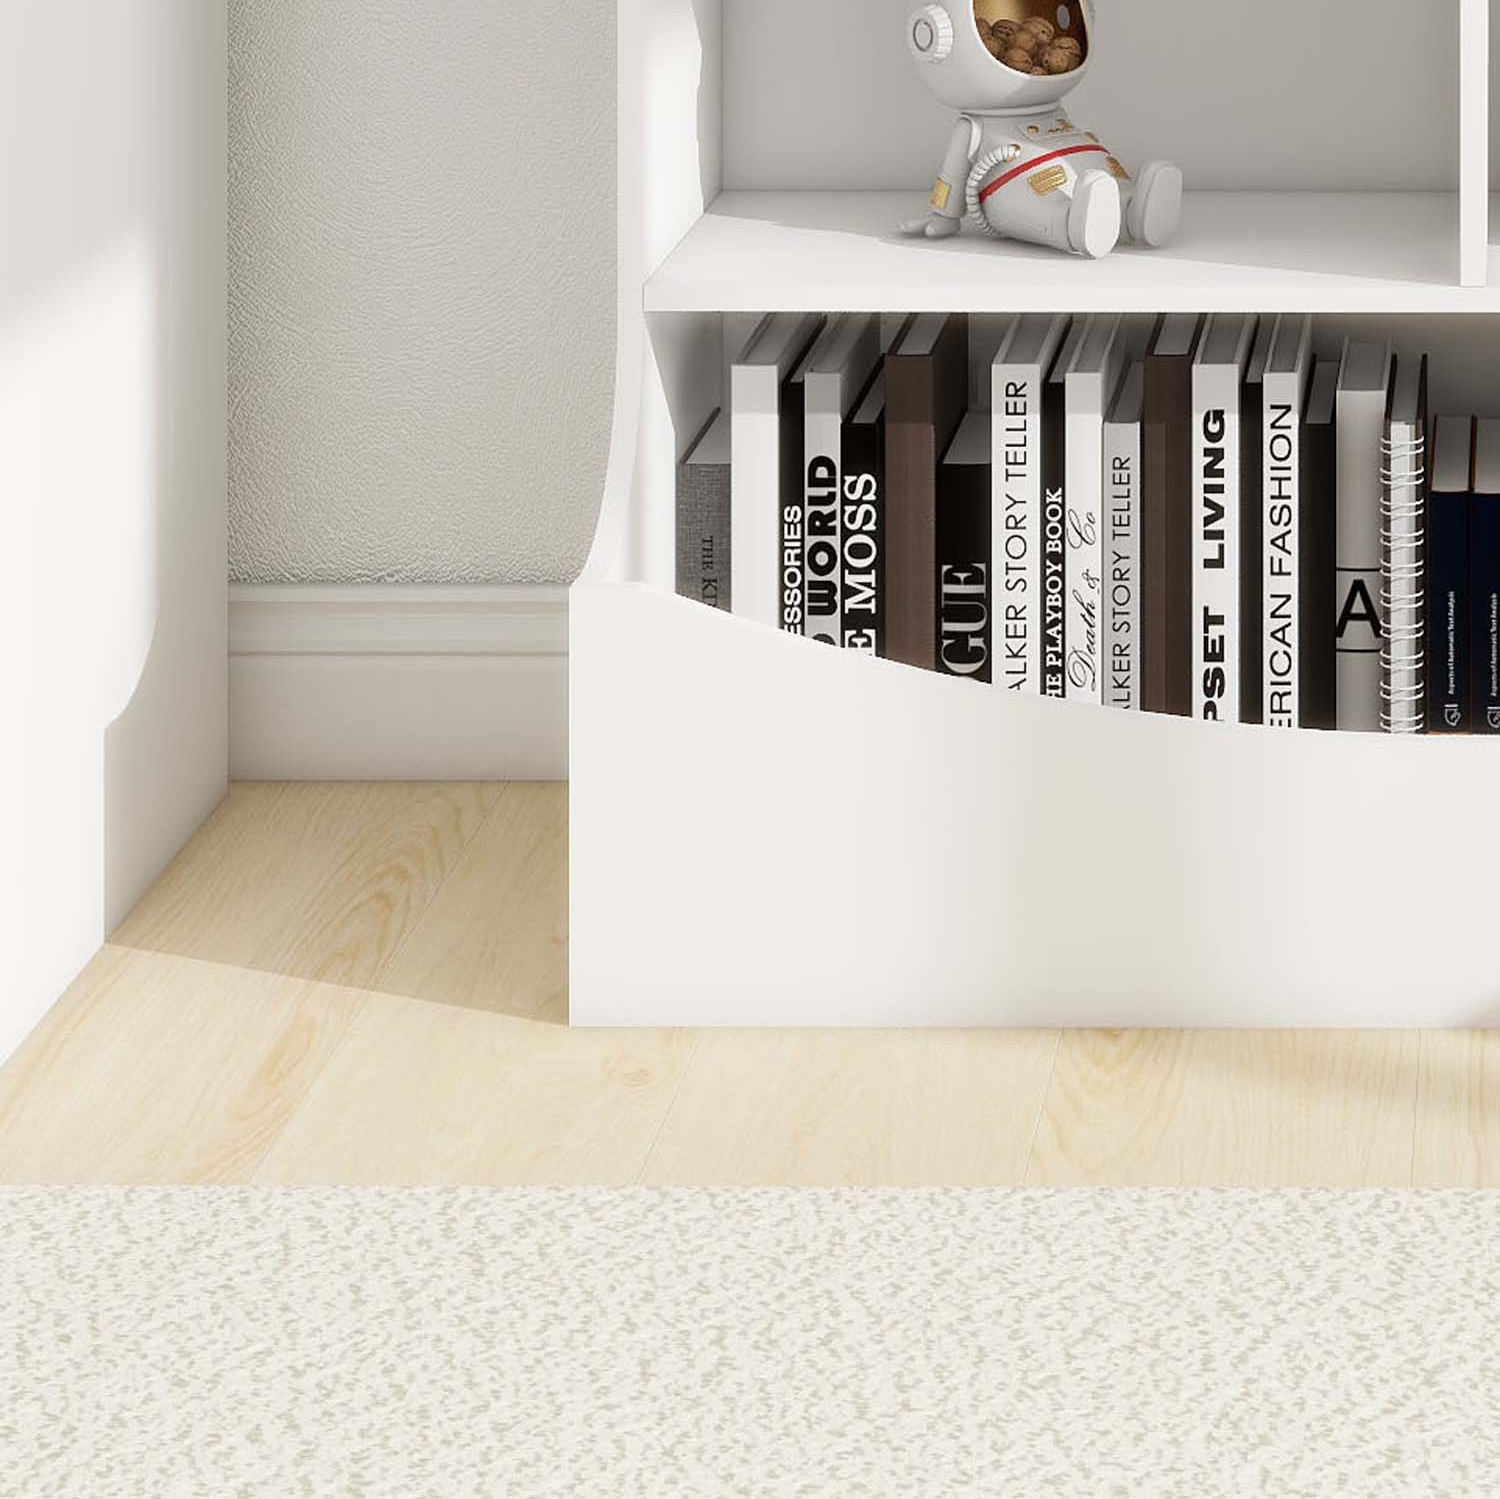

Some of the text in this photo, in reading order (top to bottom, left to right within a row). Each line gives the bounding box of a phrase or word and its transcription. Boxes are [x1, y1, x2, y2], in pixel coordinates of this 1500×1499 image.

[1005, 382, 1027, 482] TELLER
[807, 454, 838, 616] WORLD
[843, 473, 877, 614] MOSS
[1005, 493, 1027, 593] STORY
[1045, 487, 1063, 554] BOOK
[1112, 456, 1131, 541] TELLER
[1269, 404, 1292, 576] FASHION
[702, 535, 714, 571] THE
[783, 505, 802, 635] ESSORIES
[1065, 509, 1100, 691] Death & Co
[1112, 550, 1131, 633] STORY
[1203, 409, 1225, 721] PSET LIVING
[940, 562, 988, 674] GUE
[1045, 559, 1063, 667] PLAYBOY
[1336, 579, 1384, 638] A
